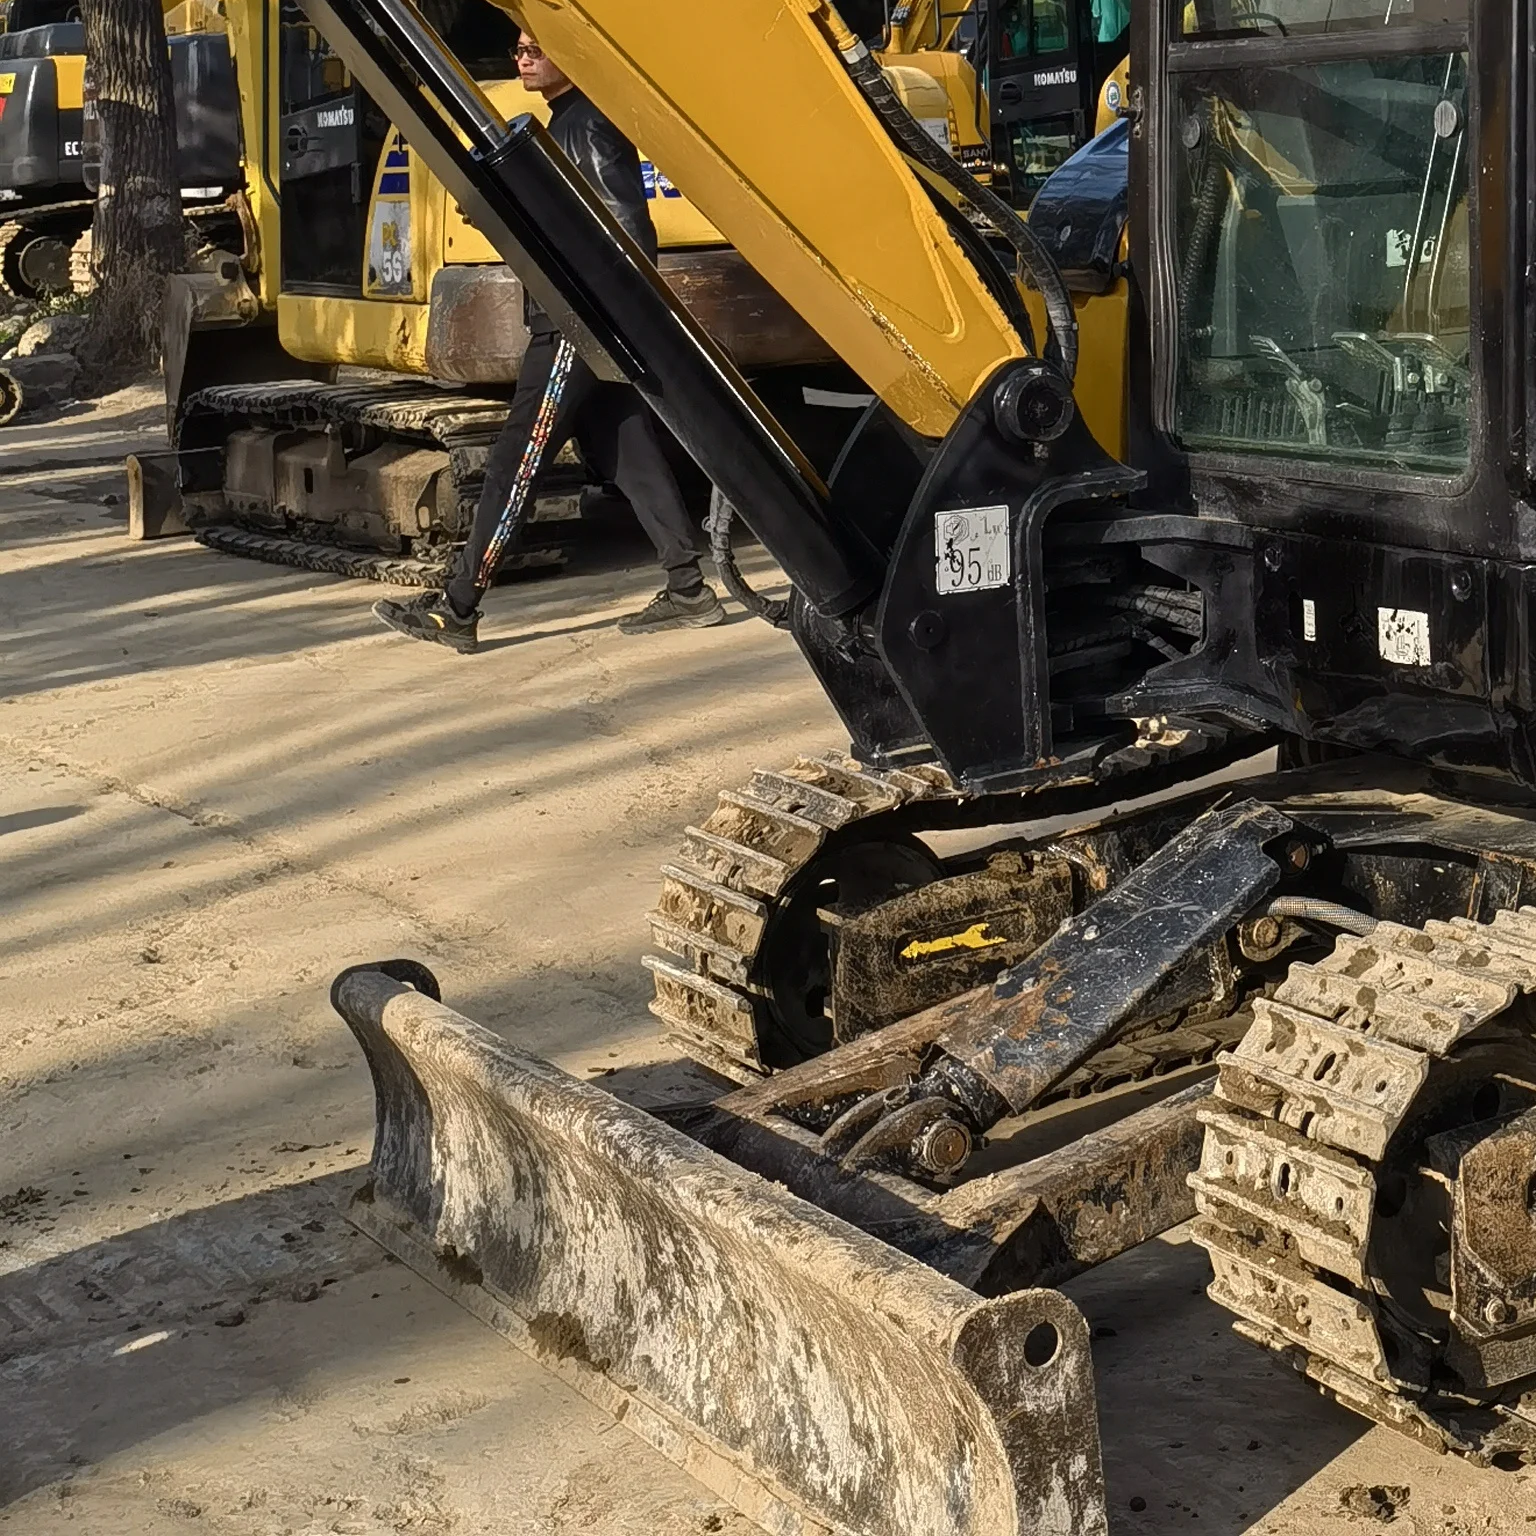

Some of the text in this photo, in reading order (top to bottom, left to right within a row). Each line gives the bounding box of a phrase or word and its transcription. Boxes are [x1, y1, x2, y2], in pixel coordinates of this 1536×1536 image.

[1033, 68, 1077, 86] KOMATSU
[317, 105, 354, 128] KOMATSU
[963, 148, 990, 159] SANY
[949, 546, 1002, 587] 95 dB
